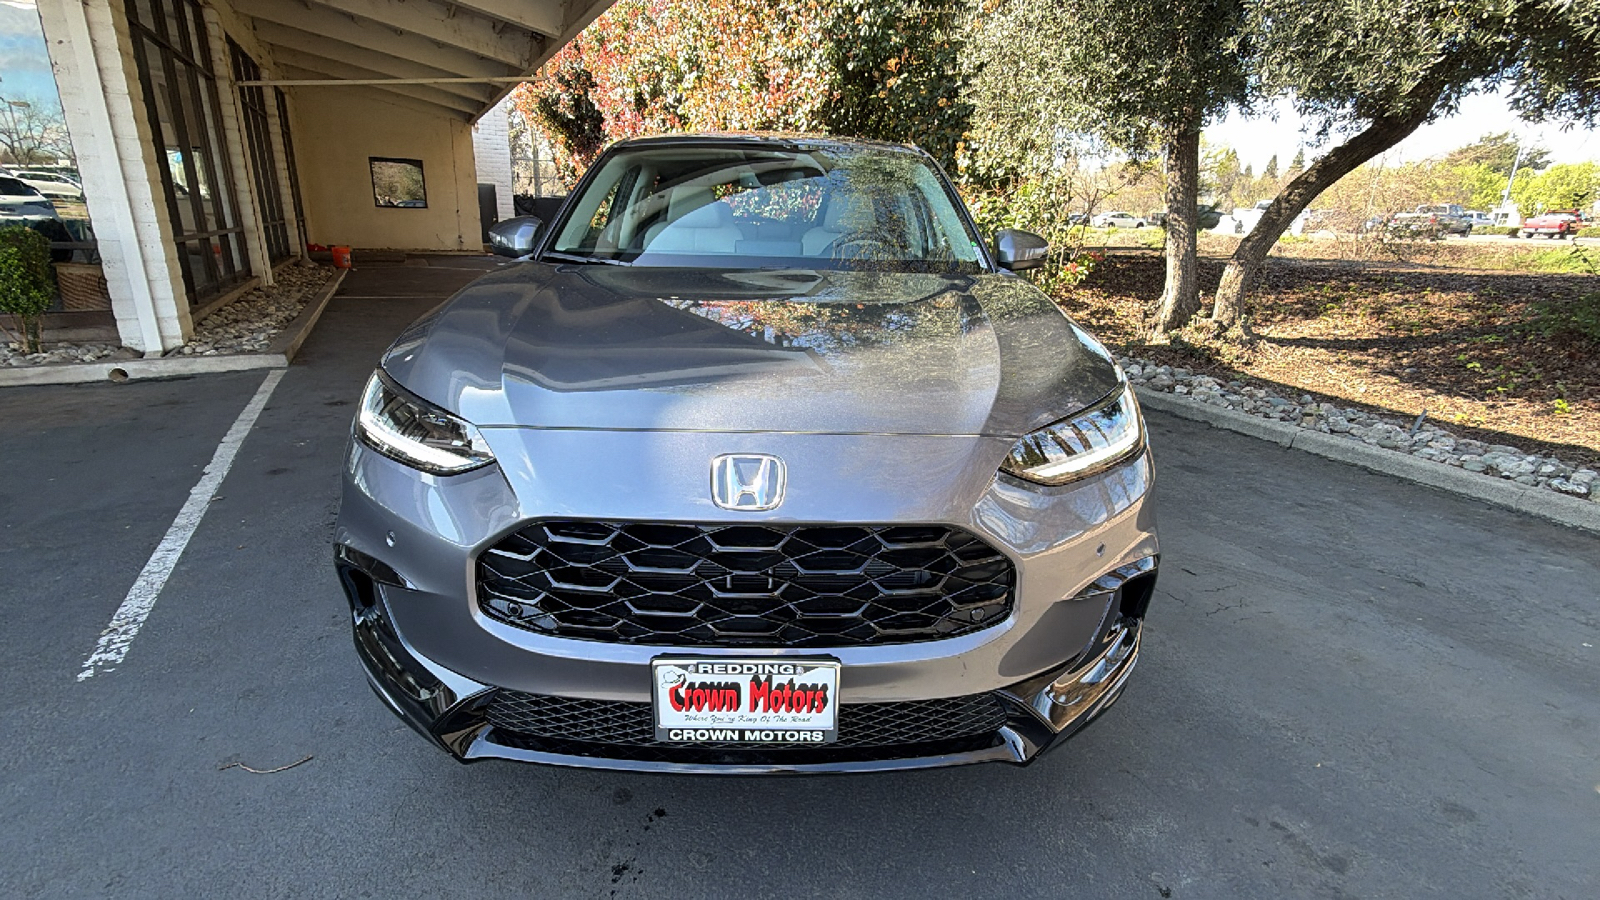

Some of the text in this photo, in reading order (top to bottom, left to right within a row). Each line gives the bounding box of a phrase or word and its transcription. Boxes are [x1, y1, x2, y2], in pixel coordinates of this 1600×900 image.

[698, 664, 795, 675] REDDING
[669, 674, 829, 714] Crown Motors
[684, 714, 708, 722] Where
[737, 715, 758, 724] King
[760, 715, 771, 724] Of
[773, 715, 788, 723] The
[790, 715, 812, 723] Road
[669, 729, 824, 742] CROWN MOTORS
